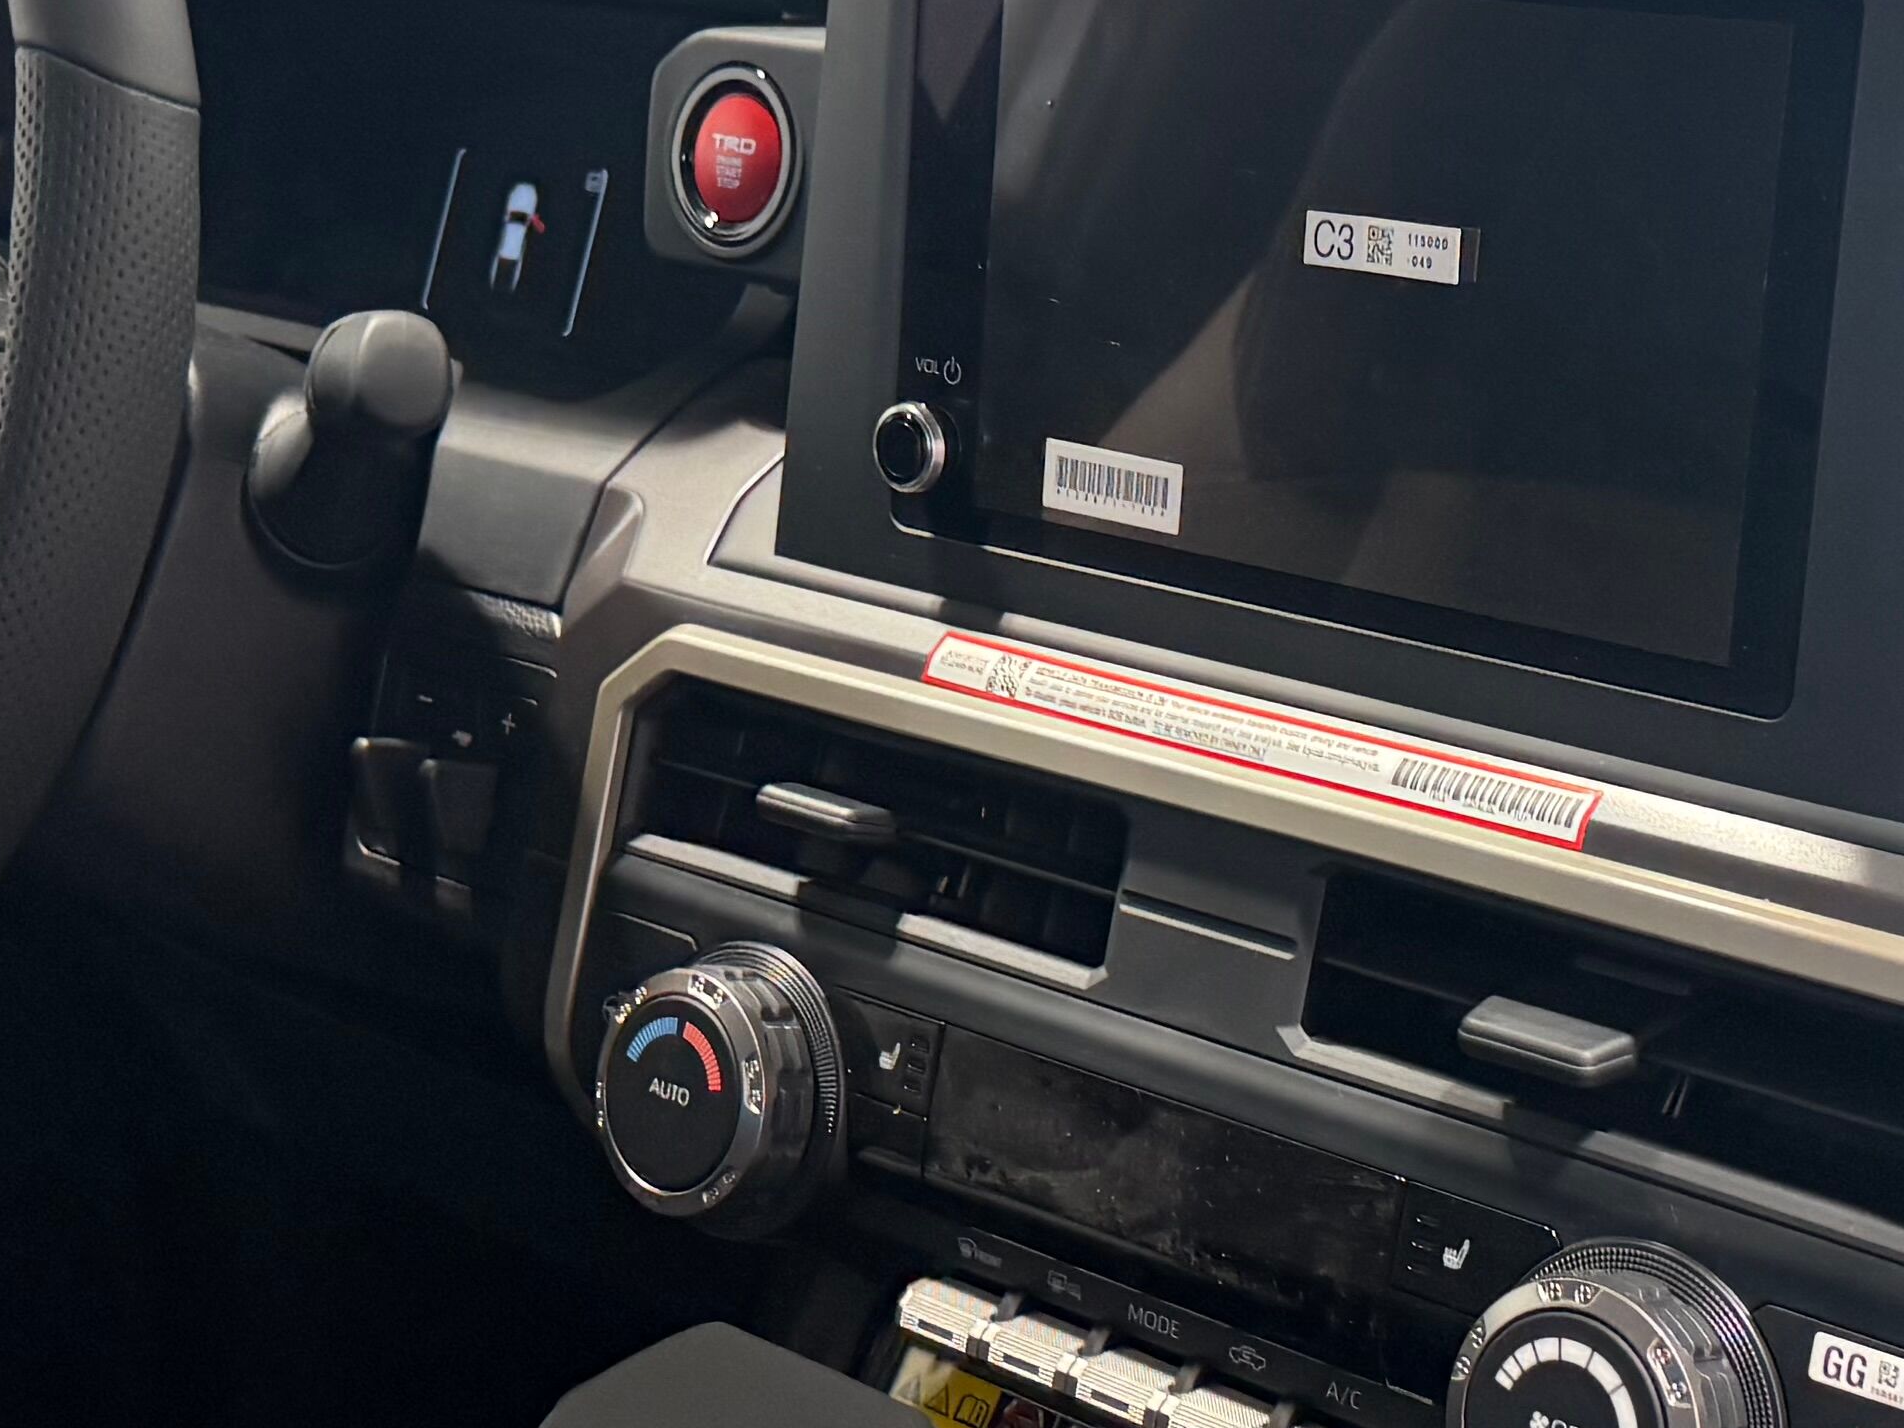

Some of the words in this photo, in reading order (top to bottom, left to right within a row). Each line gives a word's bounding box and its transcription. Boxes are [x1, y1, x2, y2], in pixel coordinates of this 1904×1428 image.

[712, 132, 757, 155] TRD
[1314, 219, 1354, 261] C3
[915, 356, 940, 375] VOL
[649, 1076, 690, 1107] AUTO
[1127, 1303, 1181, 1340] MODE
[1823, 1345, 1868, 1389] GG
[1327, 1380, 1363, 1411] A/C
